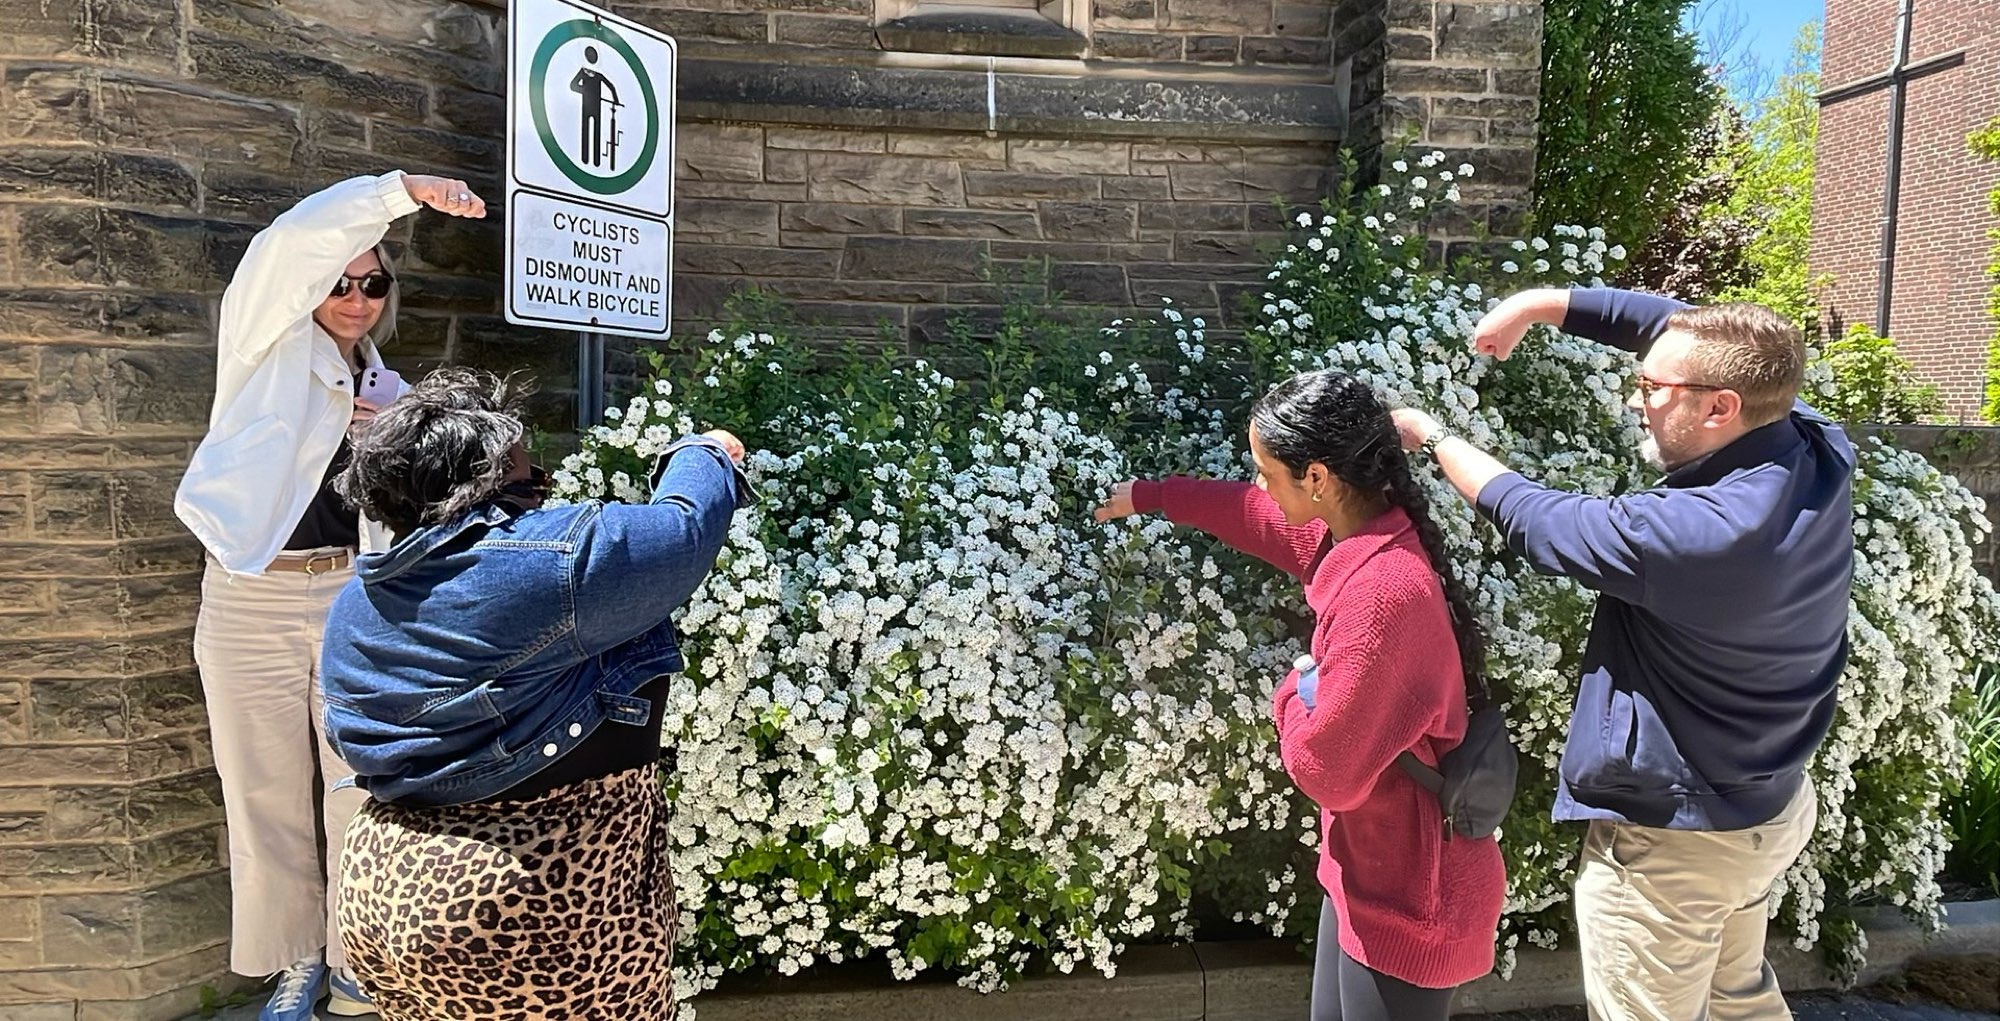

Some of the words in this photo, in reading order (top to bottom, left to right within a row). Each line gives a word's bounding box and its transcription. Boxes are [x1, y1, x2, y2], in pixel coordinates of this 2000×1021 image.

[553, 212, 640, 245] CYCLISTS
[573, 241, 622, 265] MUST
[526, 257, 623, 289] DISMOUNT
[626, 275, 661, 295] AND
[526, 282, 581, 307] WALK
[587, 292, 660, 317] BICYCLE
